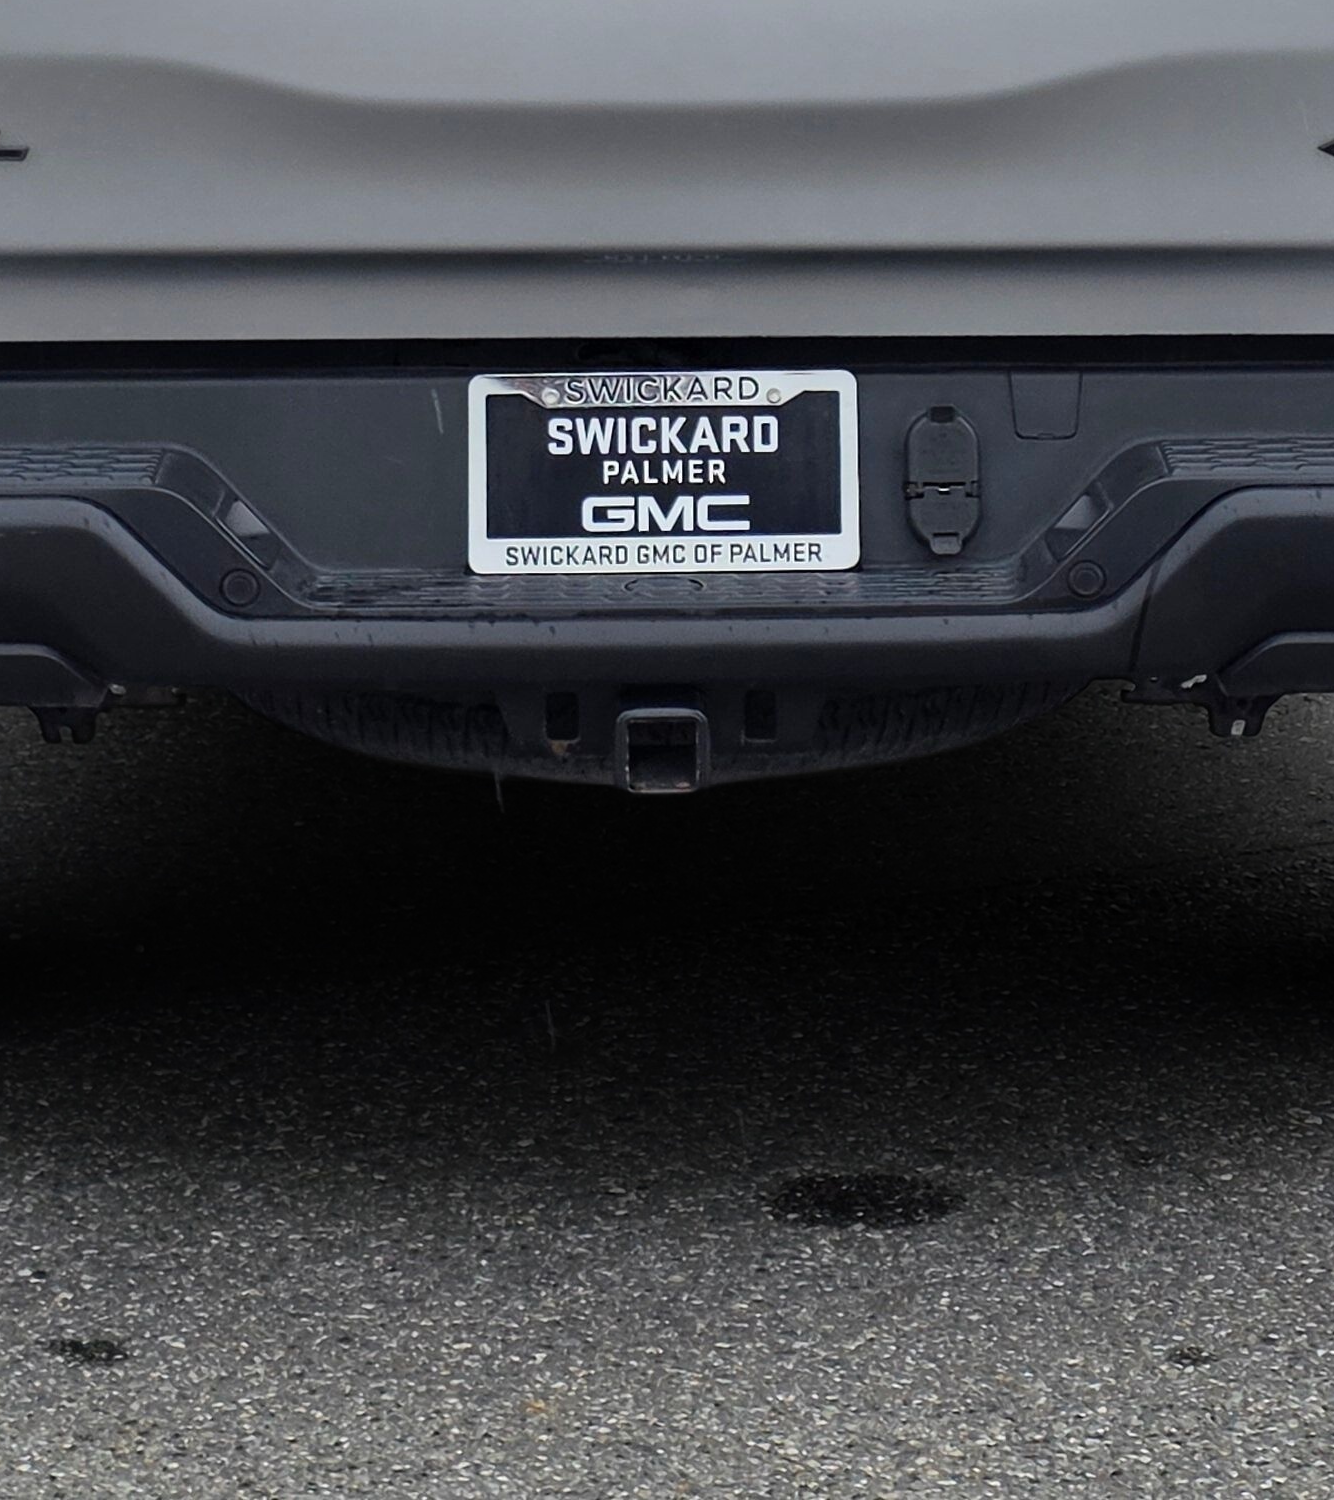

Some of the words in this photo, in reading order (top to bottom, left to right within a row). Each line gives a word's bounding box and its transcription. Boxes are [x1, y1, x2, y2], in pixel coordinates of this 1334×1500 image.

[565, 375, 760, 404] SWICKARD
[547, 415, 779, 455] SWICKARD
[602, 459, 727, 485] PALMER
[581, 494, 751, 533] GMC
[505, 544, 629, 567] SWICKARD
[636, 544, 686, 565] GMC
[694, 543, 723, 564] OF
[729, 542, 823, 563] PALMER
